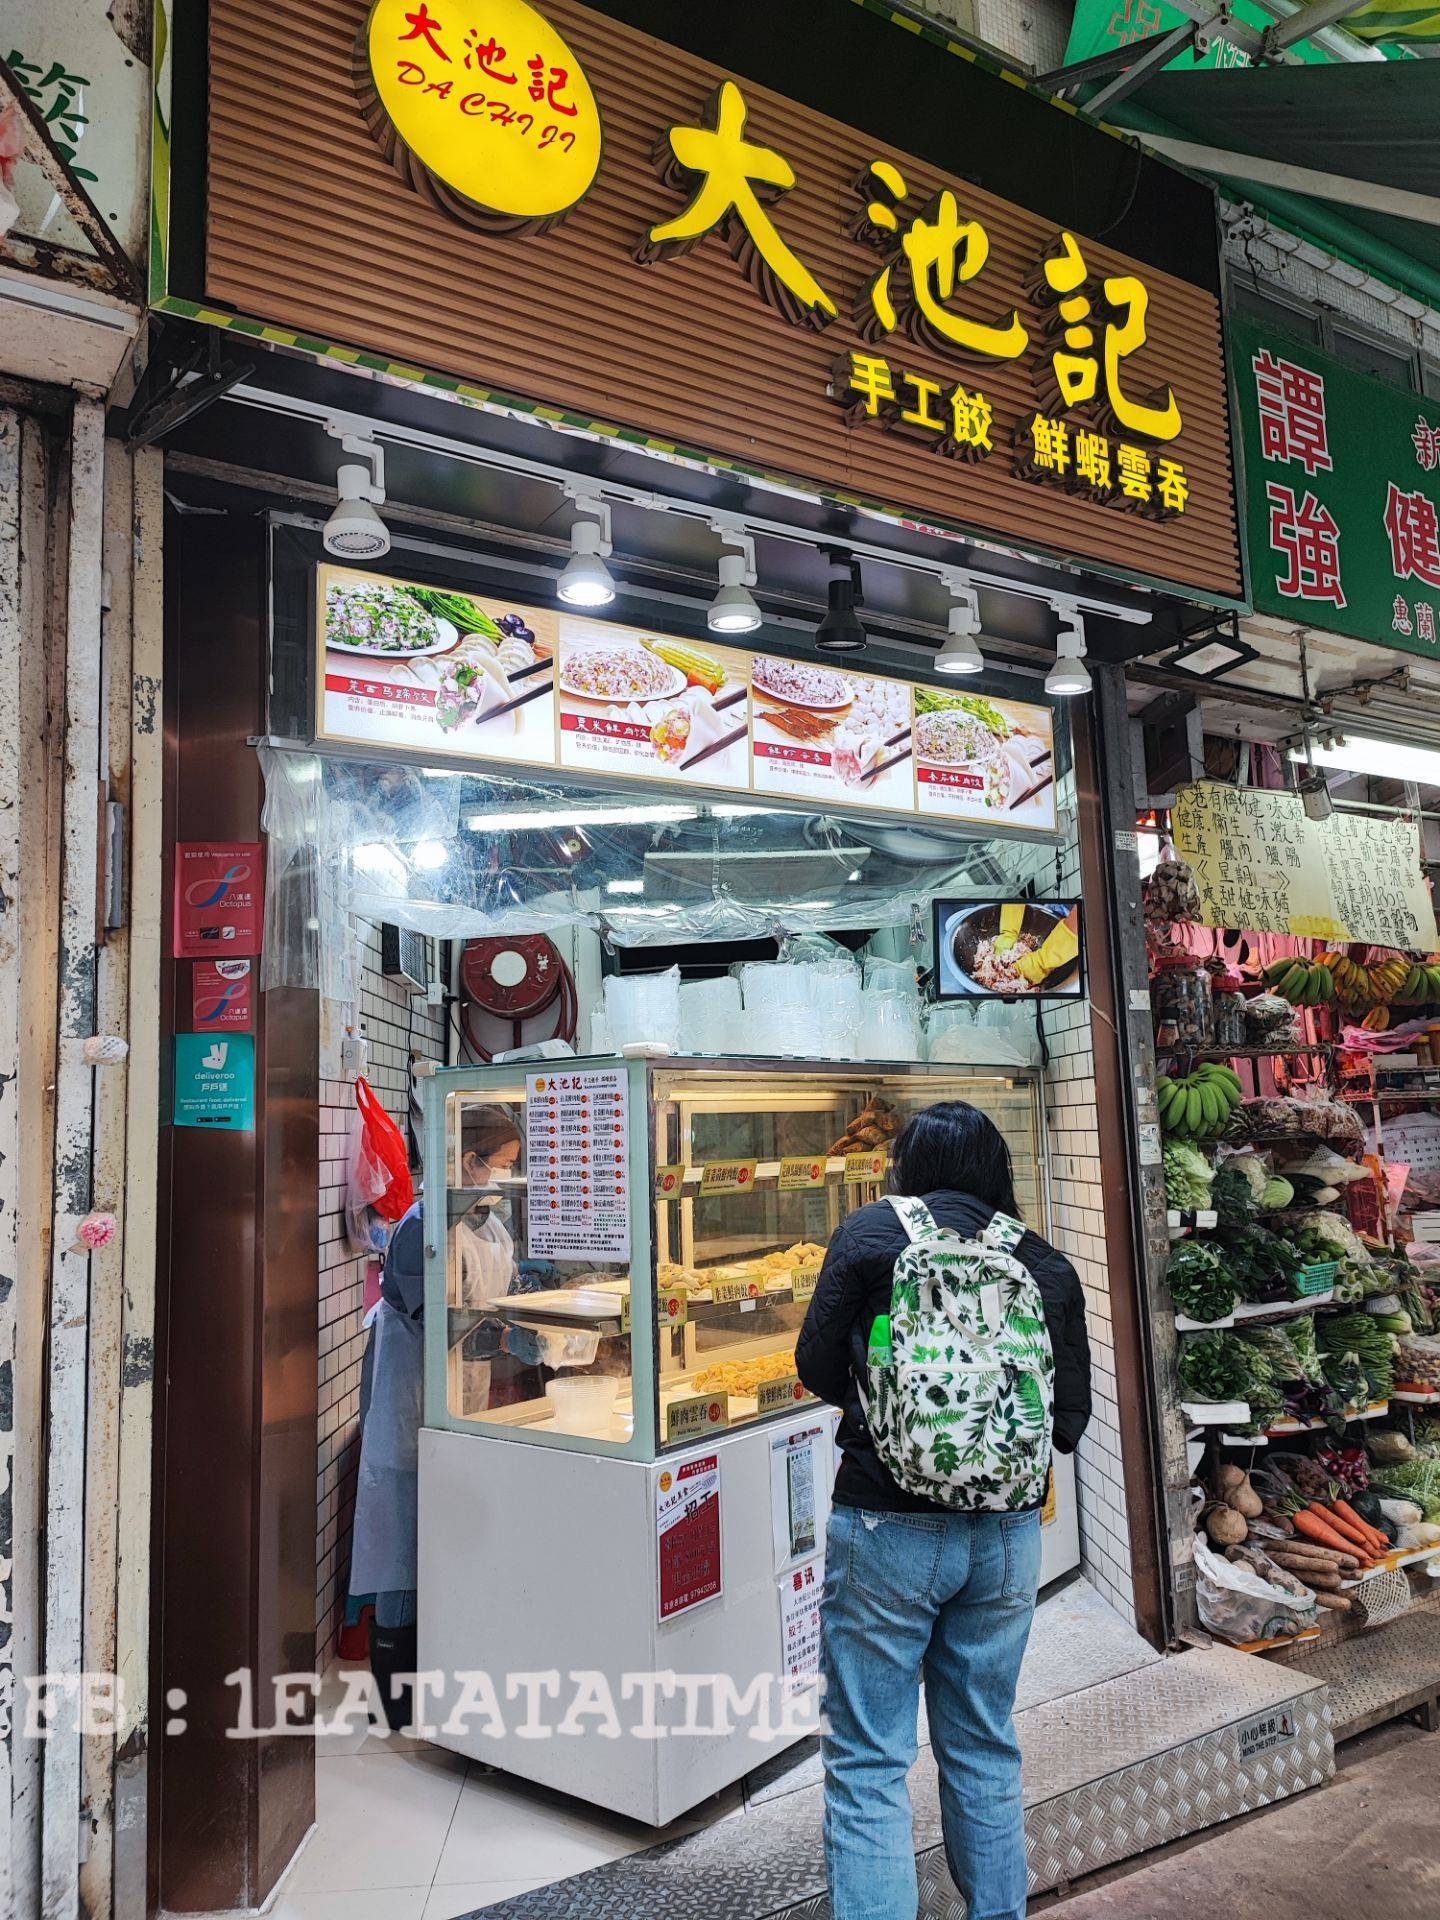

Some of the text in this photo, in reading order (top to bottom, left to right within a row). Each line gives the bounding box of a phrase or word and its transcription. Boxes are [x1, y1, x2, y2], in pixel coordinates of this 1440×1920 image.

[398, 3, 579, 118] 大池記
[396, 60, 579, 154] DA CHI JI
[649, 80, 1182, 442] 大池記
[849, 352, 1191, 513] 手工餃 鮮蝦雲吞
[219, 900, 252, 908] Octopus
[220, 1014, 248, 1022] Octopus
[194, 1071, 236, 1080] deliveroo
[1242, 1735, 1277, 1757] MIND THE STEP
